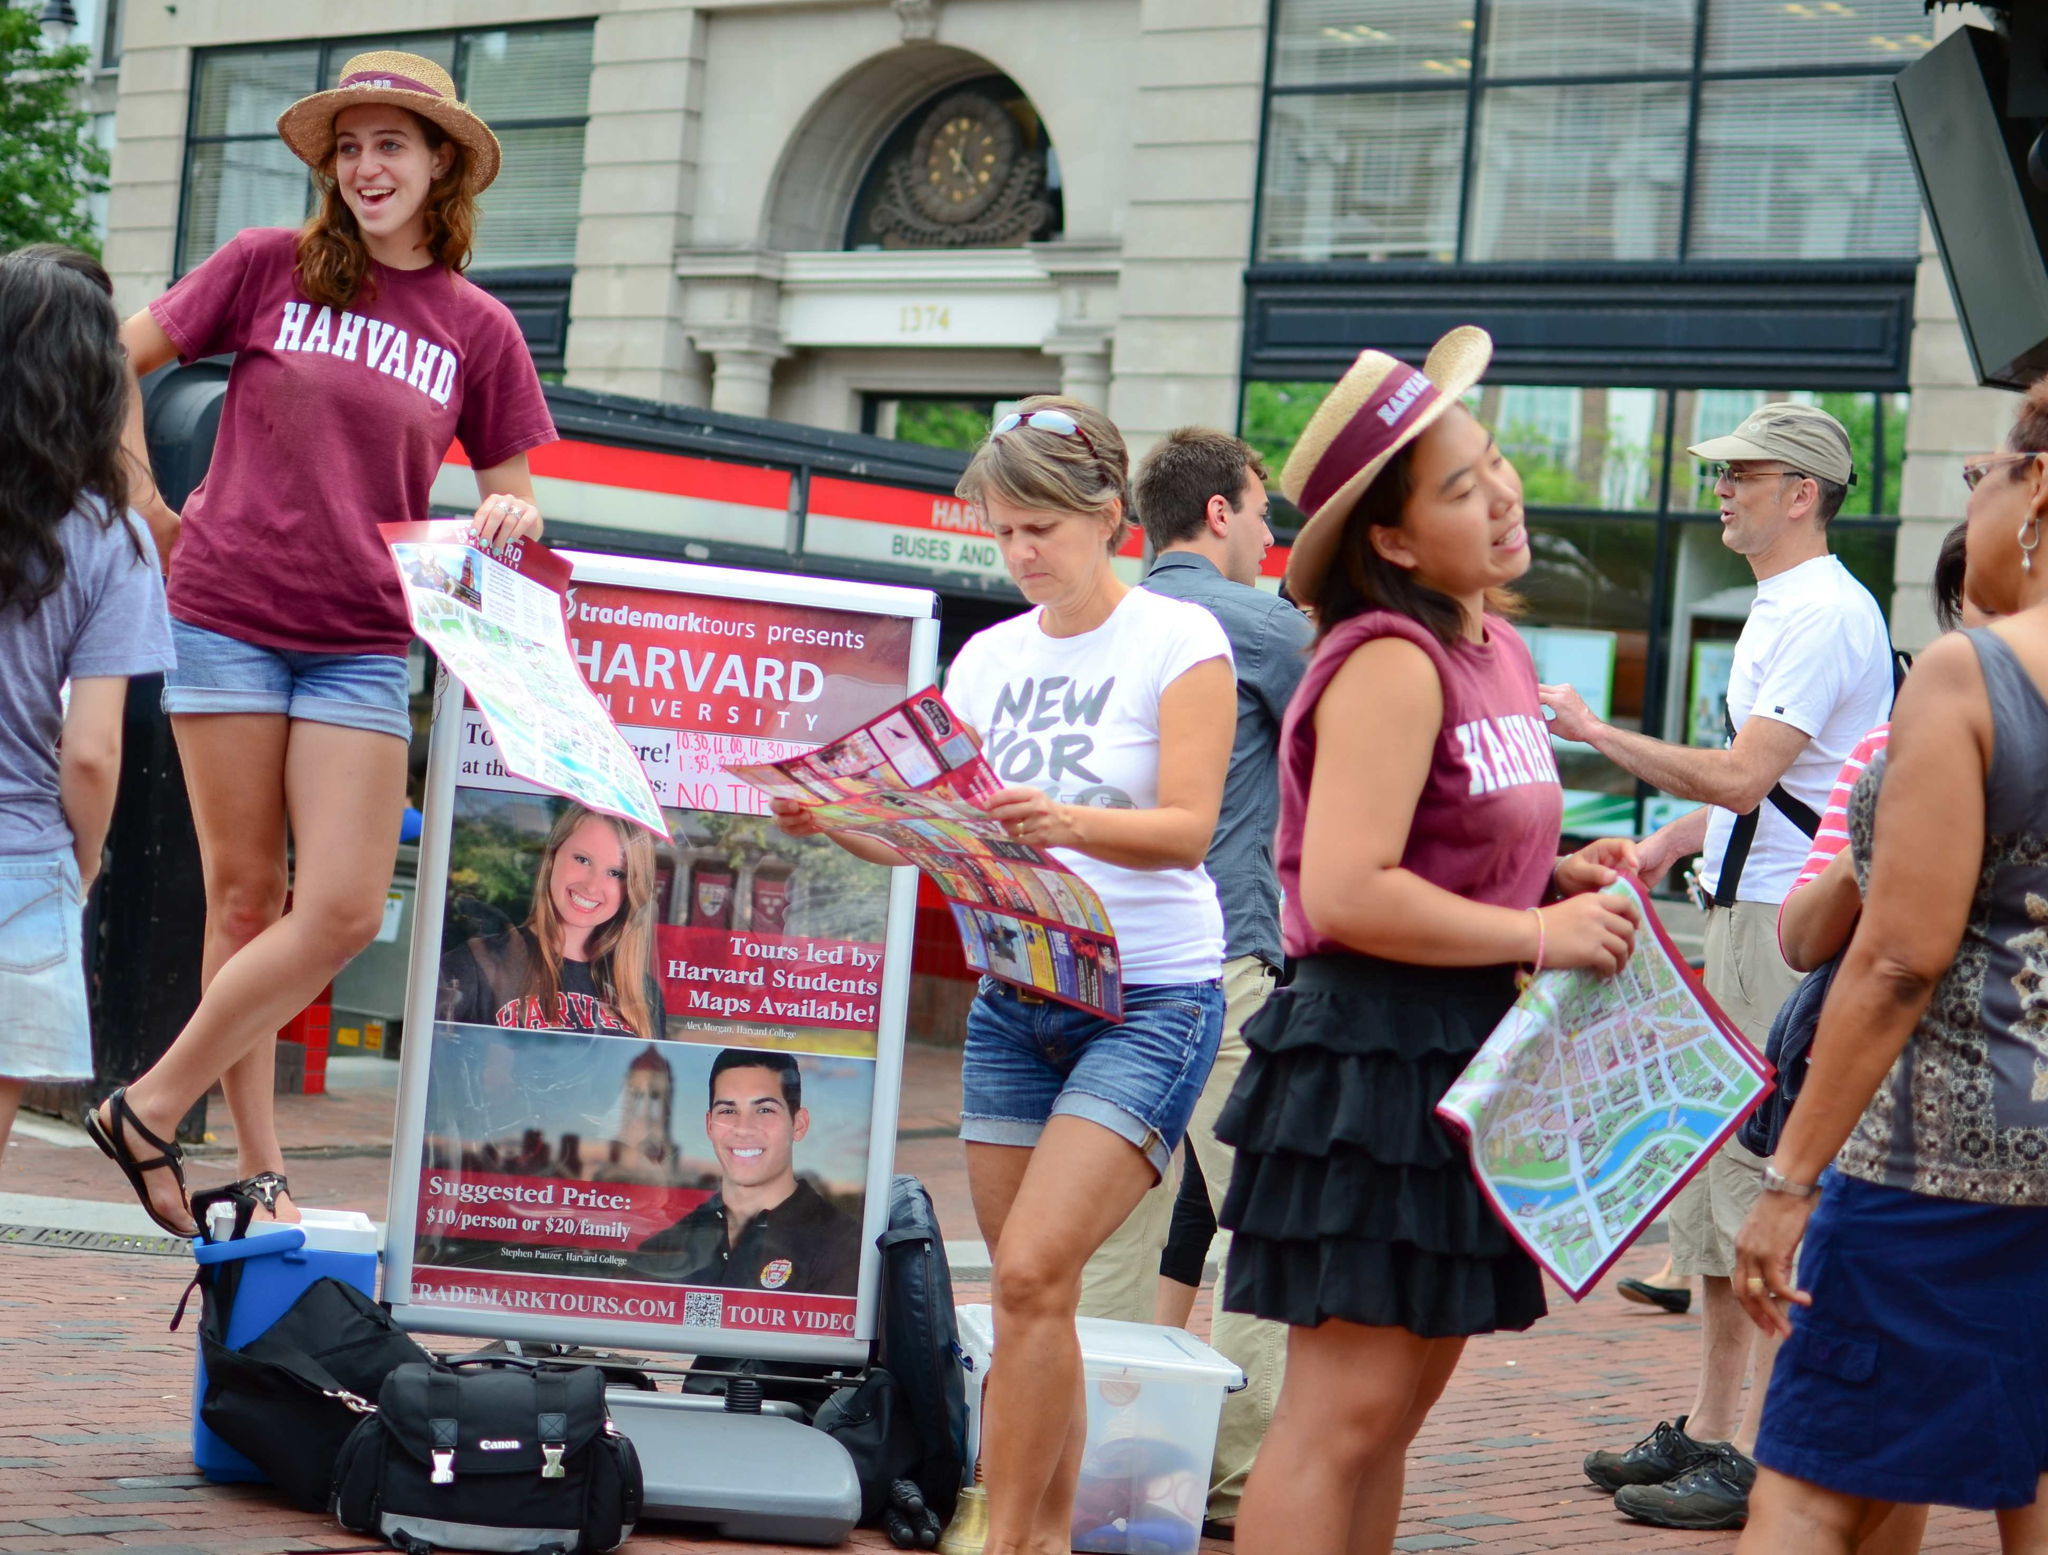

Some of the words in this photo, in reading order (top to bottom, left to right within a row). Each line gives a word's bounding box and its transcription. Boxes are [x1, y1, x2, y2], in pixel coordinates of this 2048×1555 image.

[273, 302, 457, 405] HAHVAHD
[892, 534, 951, 561] BUSES
[958, 543, 996, 568] AND
[580, 602, 756, 638] trademarktours
[767, 623, 865, 650] presents
[572, 638, 824, 703] HARVARD
[597, 693, 819, 732] NIVERSITY
[991, 676, 1116, 733] NEW
[466, 722, 494, 746] To
[462, 760, 479, 774] at
[678, 783, 718, 811] NO
[730, 936, 798, 961] Tours
[807, 943, 843, 965] led
[852, 948, 881, 972] by
[667, 960, 764, 986] Harvard
[772, 970, 878, 996] Students
[688, 990, 750, 1016] Maps
[757, 997, 875, 1023] Available!
[685, 1021, 701, 1031] Alex
[702, 1022, 734, 1036] Morgan,
[736, 1025, 767, 1037] Harvard
[769, 1028, 797, 1040] College
[429, 1176, 553, 1204] Suggested
[562, 1187, 631, 1210] Price:
[426, 1206, 517, 1230] $10/person
[522, 1219, 540, 1232] or
[545, 1217, 631, 1243] $20/family
[501, 1247, 532, 1260] Stephen
[566, 1252, 597, 1264] Harvard
[599, 1255, 627, 1267] College
[410, 1282, 676, 1319] TRADEMARKTOURS.COM
[728, 1305, 786, 1327] TOUR
[791, 1310, 856, 1331] VIDEO
[480, 1439, 519, 1450] Canon
